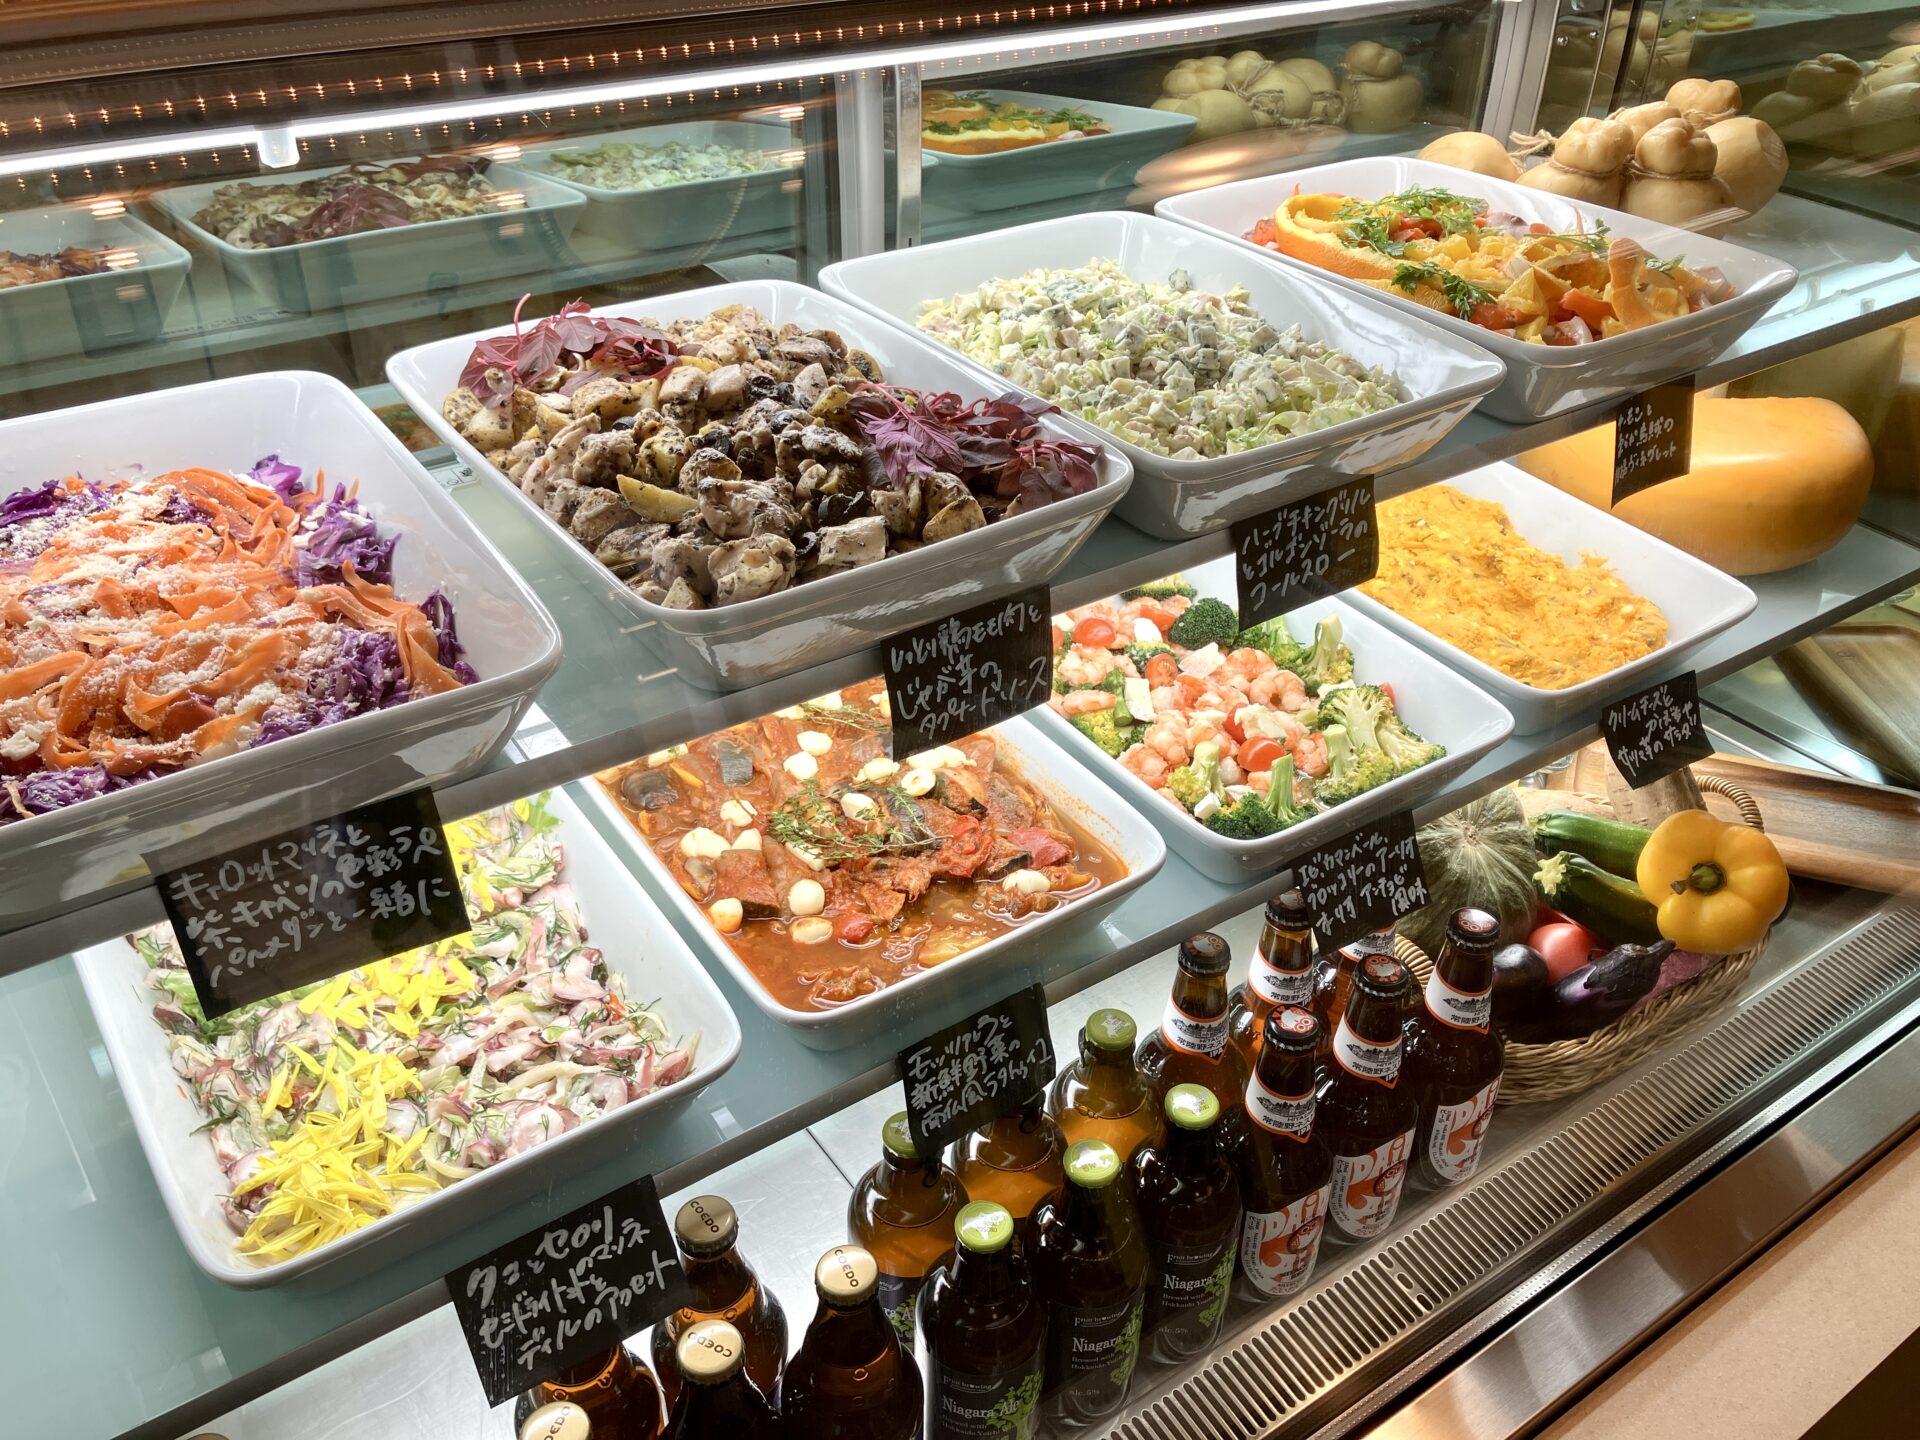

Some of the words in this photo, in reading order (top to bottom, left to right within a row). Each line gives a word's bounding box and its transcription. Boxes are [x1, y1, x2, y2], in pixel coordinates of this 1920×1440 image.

[1242, 488, 1371, 555] ハーブチキングリル
[1242, 518, 1368, 580] とゴルゴンゾーラの
[1250, 548, 1356, 612] コールスロー
[1608, 685, 1674, 732] クリームチーズと
[170, 824, 371, 910] キャロットマリネと
[185, 825, 443, 949] 紫キャベツの色彩ラペ
[911, 1033, 1021, 1110] 新鮮野菜の
[690, 1201, 719, 1233] COEDO
[467, 1205, 613, 1309] タコとセロリ
[835, 1249, 859, 1287] COEDO
[1163, 1274, 1212, 1291] Niagara
[516, 1249, 678, 1371] ディルのアクセント
[902, 1306, 915, 1321] Al
[688, 1332, 732, 1358] COEDO
[1072, 1335, 1121, 1353] Niagara
[544, 1406, 571, 1440] OEDO
[942, 1395, 994, 1419] Niagara
